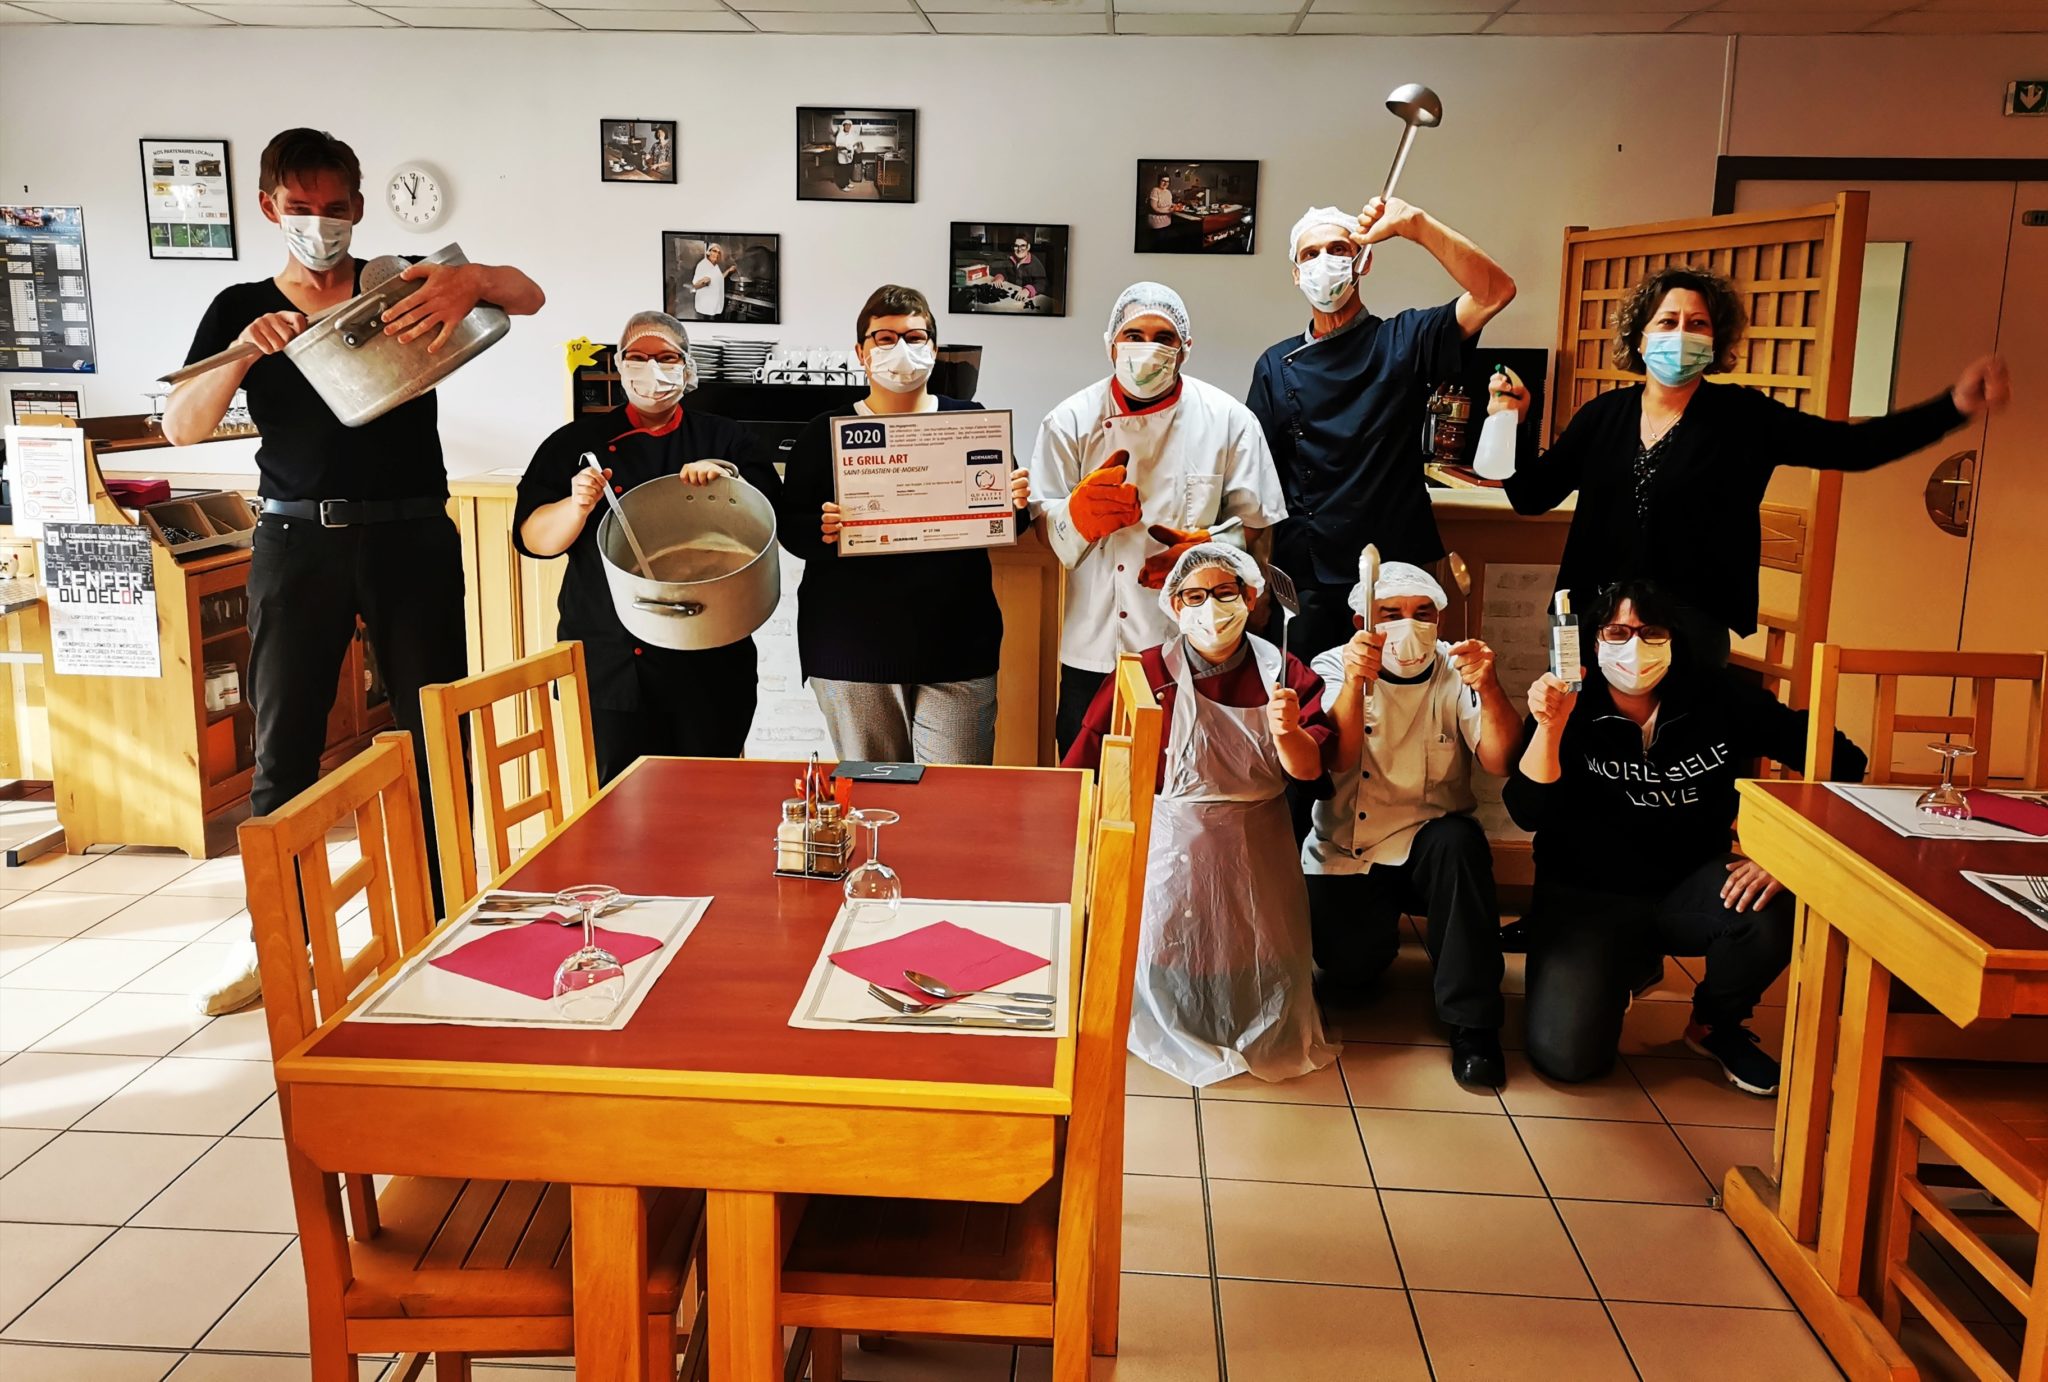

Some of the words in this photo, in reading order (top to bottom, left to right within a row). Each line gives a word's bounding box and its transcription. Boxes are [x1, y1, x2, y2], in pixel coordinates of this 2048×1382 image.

[846, 429, 881, 444] 2020
[842, 456, 853, 466] LE
[857, 455, 886, 465] GRILL
[888, 454, 908, 464] ART
[58, 570, 143, 592] L'ENFER
[60, 588, 80, 602] DU
[1584, 754, 1661, 783] MORE
[1665, 743, 1728, 782] SELF
[1626, 787, 1698, 807] LOVE
